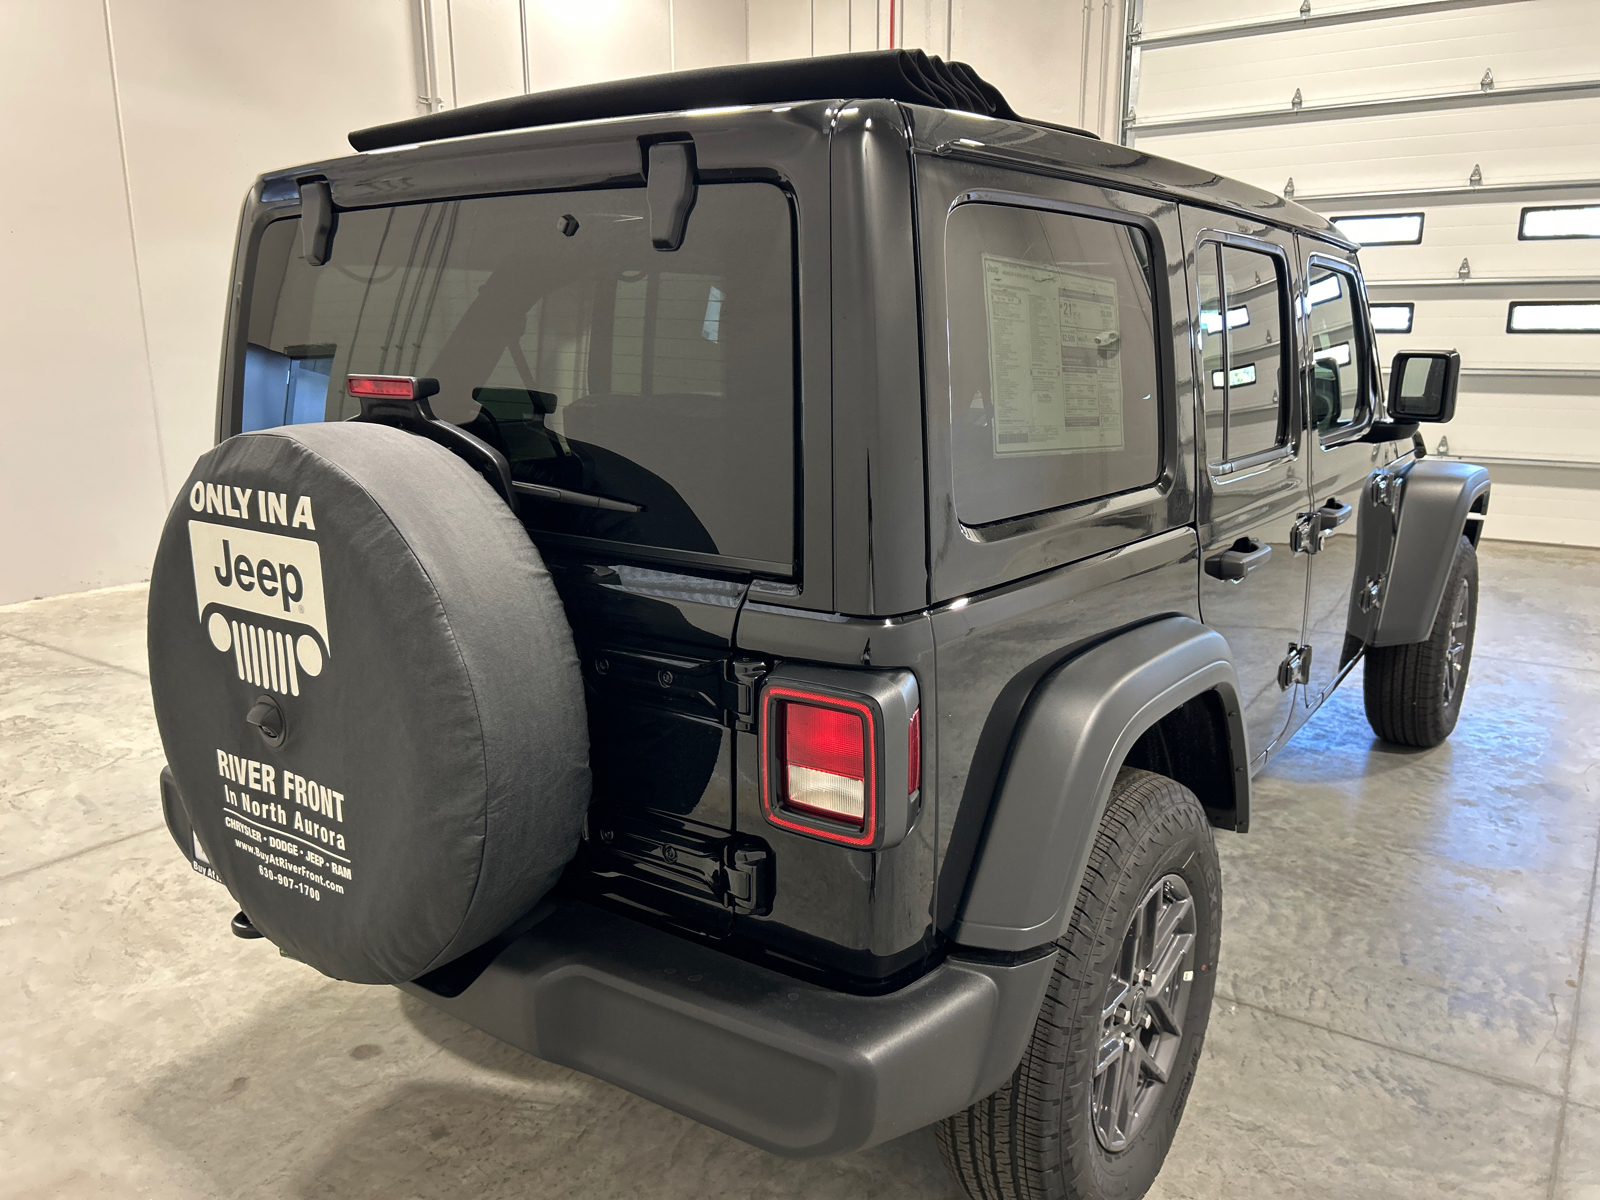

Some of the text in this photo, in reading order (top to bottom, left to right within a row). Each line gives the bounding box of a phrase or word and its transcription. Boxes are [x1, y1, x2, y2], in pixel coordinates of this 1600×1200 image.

[1063, 302, 1072, 316] 21
[189, 480, 316, 530] ONLY IN A
[214, 539, 304, 612] Jeep
[216, 749, 345, 822] RIVER FRONT
[224, 784, 346, 851] In North Aurora
[193, 860, 207, 876] Buy
[225, 816, 352, 880] CHRYSLER DODGE JEEP RAM
[235, 839, 345, 894] www.BuyAtRiverFront.com
[258, 865, 320, 902] 630-907-1700
